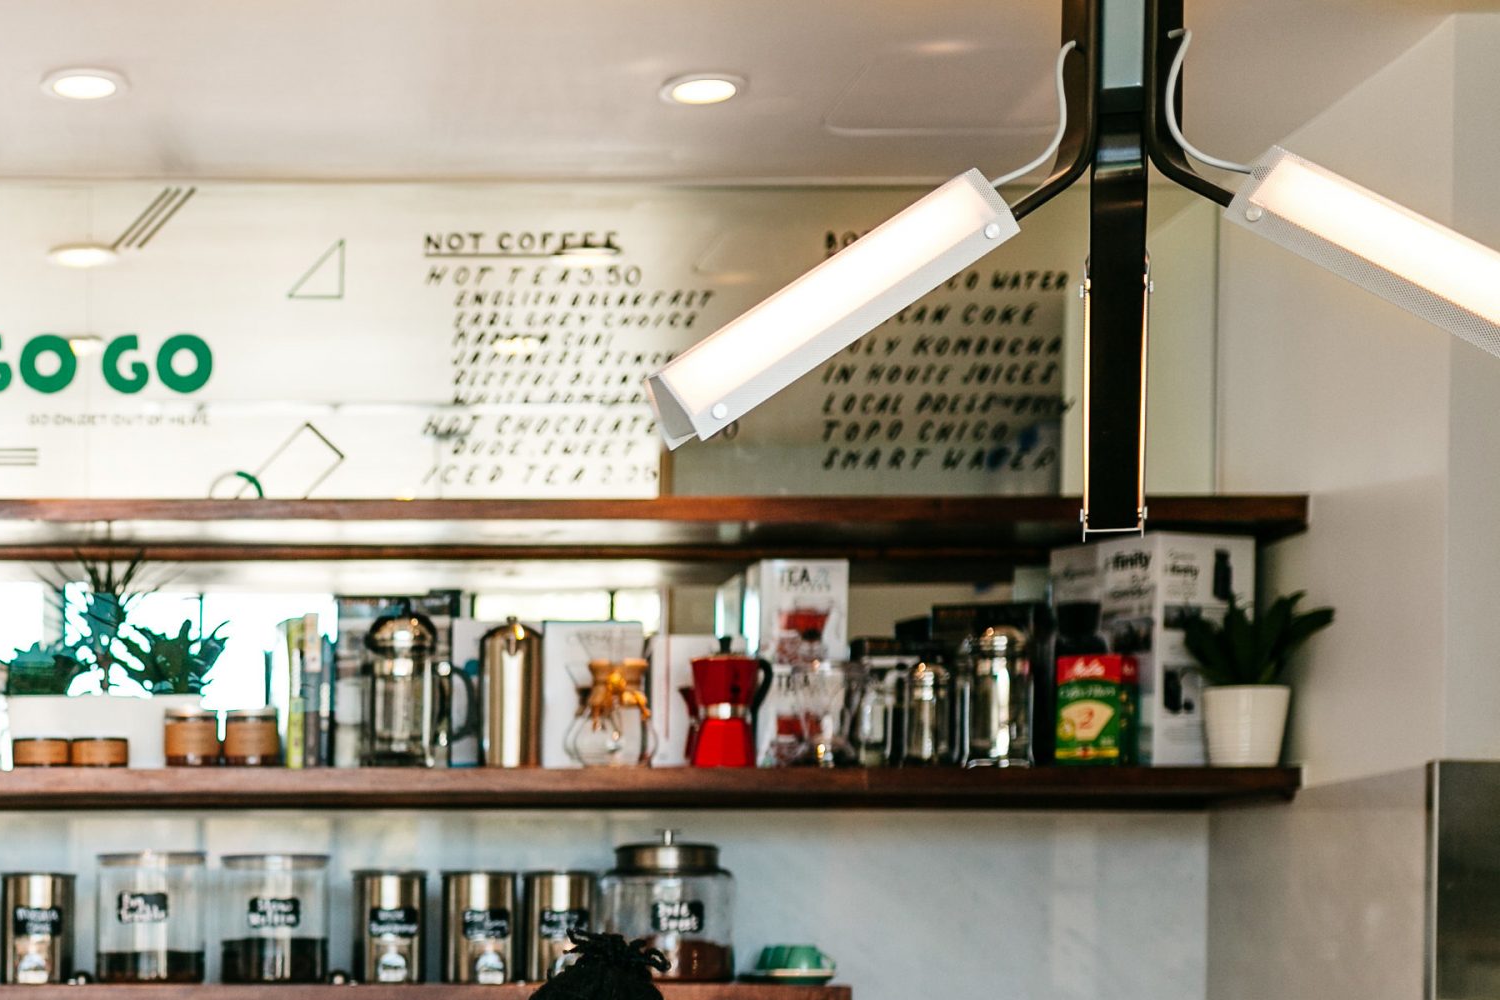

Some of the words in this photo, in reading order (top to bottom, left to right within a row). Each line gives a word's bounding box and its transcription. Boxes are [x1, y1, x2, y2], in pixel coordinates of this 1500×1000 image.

[423, 231, 486, 251] NOT
[495, 231, 621, 251] COFFEE
[424, 266, 494, 287] HOT
[508, 266, 571, 286] TEA
[990, 270, 1069, 291] WATER
[453, 290, 560, 307] ENGLISH
[570, 289, 716, 309] BREAKFAST
[453, 312, 513, 328] EARL
[961, 302, 1039, 325] COKE
[911, 336, 1064, 357] KOMBUCHA
[102, 334, 213, 394] GO
[596, 350, 678, 366] SENCH
[821, 363, 857, 385] IN
[866, 362, 953, 385] HOUSE
[960, 362, 1060, 385] JUICES
[821, 392, 904, 415] LOCAL
[422, 414, 482, 436] HOT
[496, 415, 658, 435] CHOCOLATE
[821, 419, 904, 442] TOPO
[917, 419, 1009, 442] CHICO
[822, 448, 930, 471] SMART
[422, 465, 505, 485] ICED
